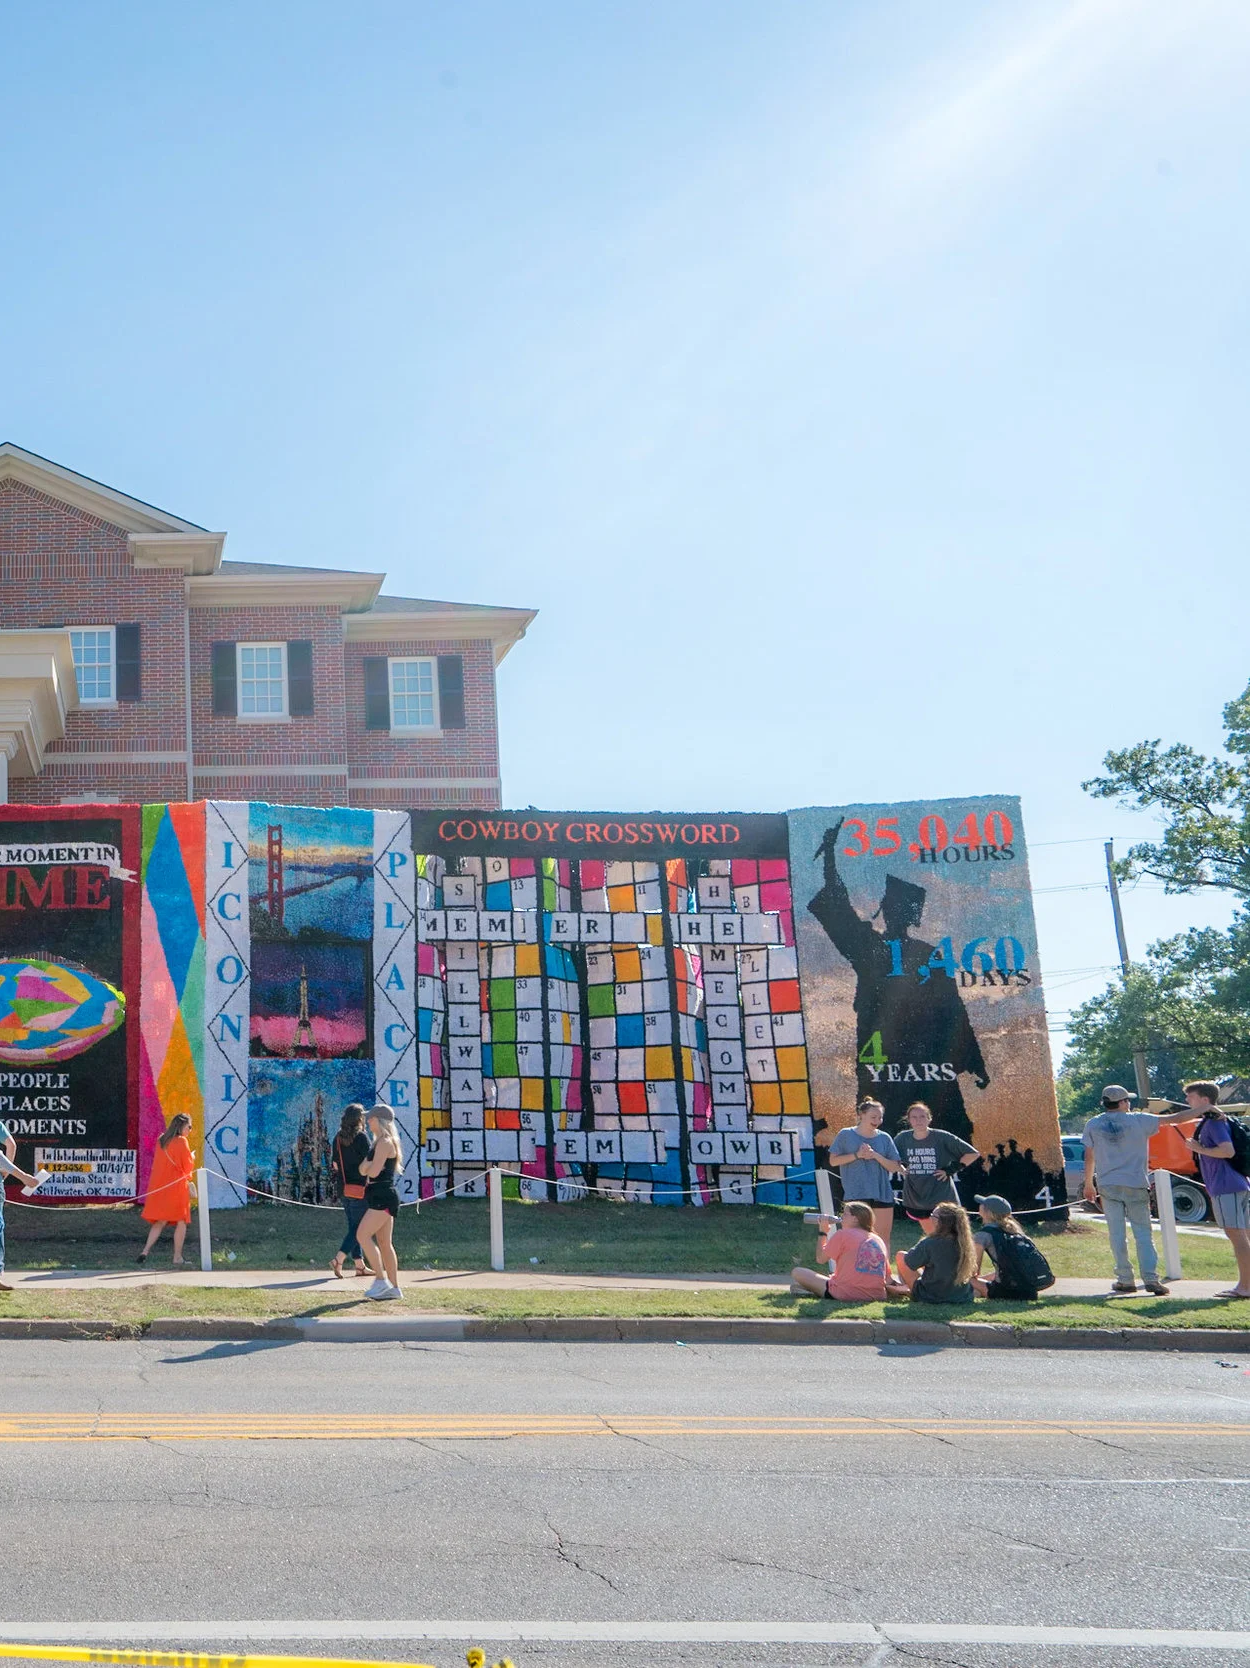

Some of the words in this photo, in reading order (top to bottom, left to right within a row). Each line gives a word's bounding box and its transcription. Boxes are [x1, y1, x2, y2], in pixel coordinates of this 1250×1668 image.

[438, 820, 559, 841] COWBOY
[566, 822, 740, 844] CROSSWORD
[842, 811, 1013, 861] 35,040
[6, 847, 94, 863] MOMENT
[97, 847, 115, 861] IN
[919, 843, 1015, 863] HOURS
[885, 936, 1025, 985] 1,460
[960, 968, 1031, 988] DAYS
[859, 1031, 888, 1071] 4
[865, 1062, 958, 1082] YEARS
[915, 1147, 936, 1156] HOURS
[97, 1163, 134, 1173] 10/14/17
[45, 1174, 86, 1184] lahoma
[88, 1174, 113, 1184] State
[404, 1180, 414, 1194] 2
[36, 1186, 84, 1196] Stillwater,
[86, 1187, 101, 1196] OK
[106, 1187, 132, 1196] 74074
[1035, 1185, 1054, 1208] 4
